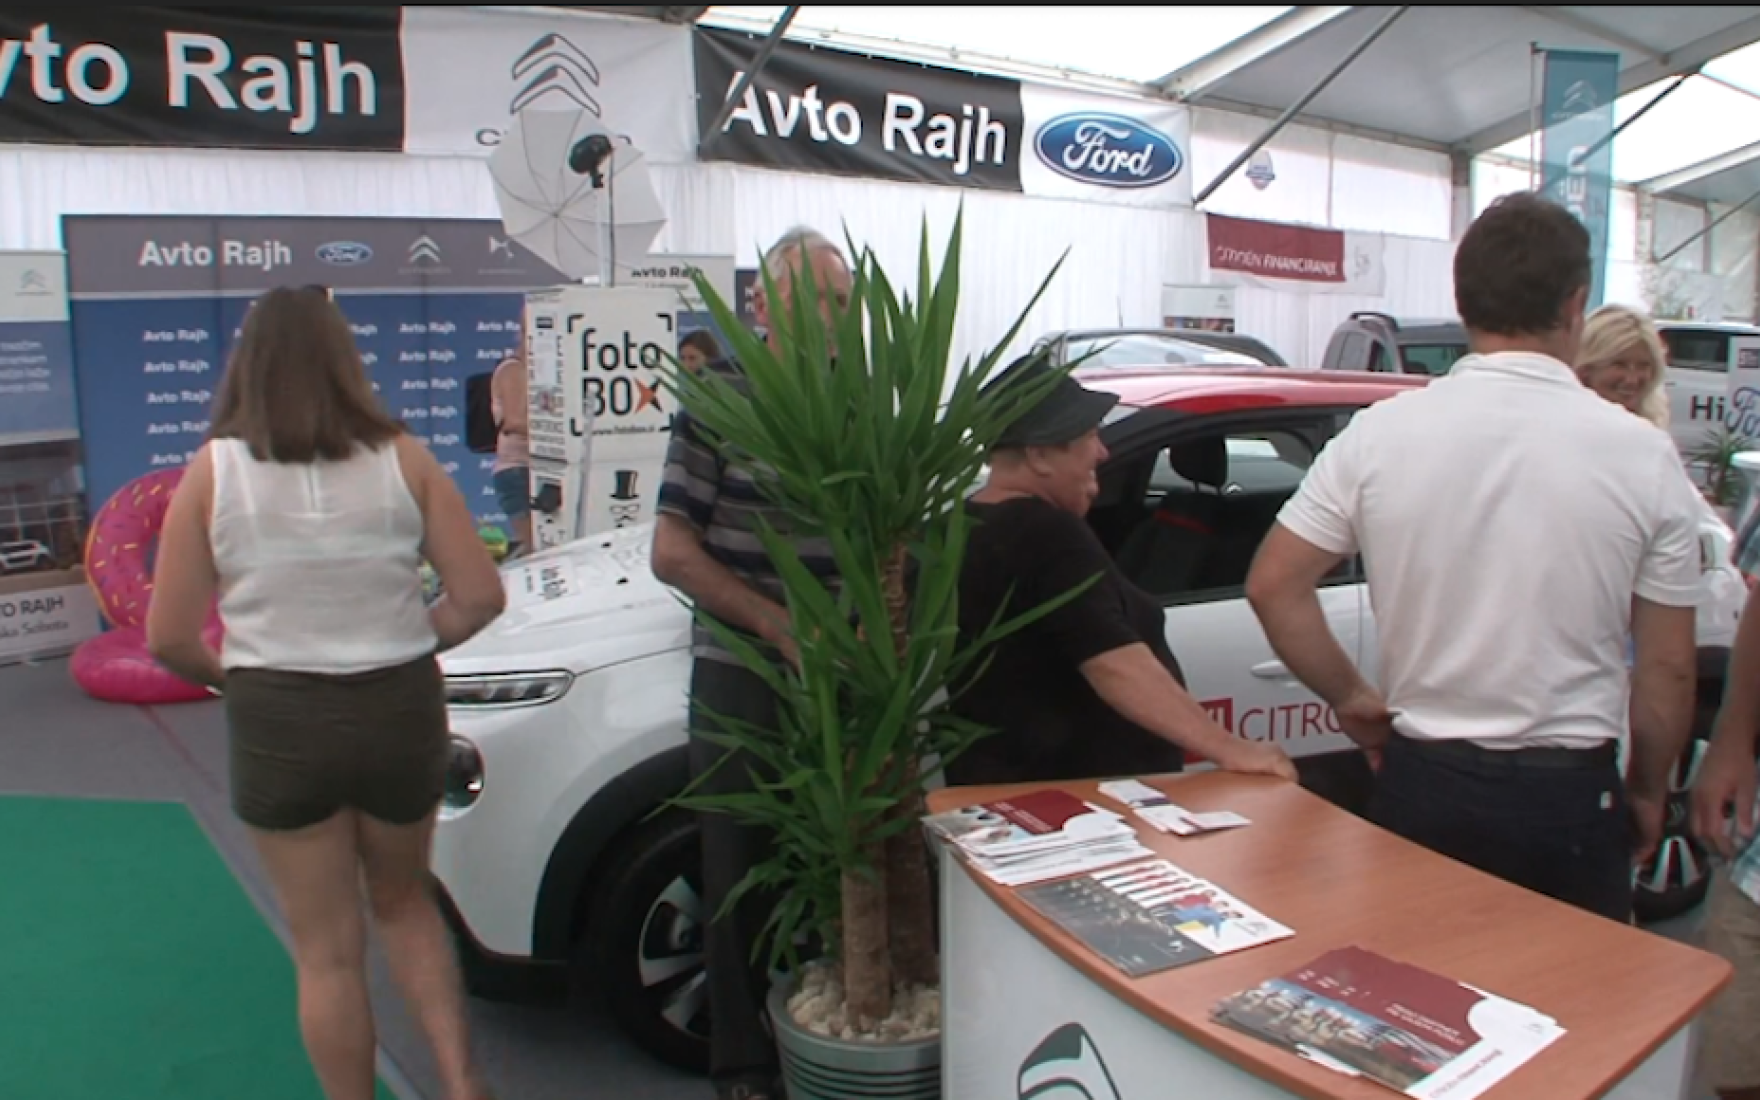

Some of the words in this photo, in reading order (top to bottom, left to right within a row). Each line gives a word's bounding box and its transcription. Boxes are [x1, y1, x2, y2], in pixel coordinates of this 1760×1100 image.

[165, 30, 376, 134] Rajh
[722, 71, 863, 145] Avto
[882, 92, 1005, 176] Rajh
[1063, 121, 1155, 177] Ford
[138, 239, 213, 266] Avto
[222, 240, 292, 272] Rajh
[400, 323, 427, 333] Avto
[428, 321, 456, 334] Rajh
[476, 321, 503, 332] Avto
[143, 331, 175, 341] Avto
[178, 329, 209, 343] Rajh
[400, 351, 427, 362] Avto
[428, 349, 456, 362] Rajh
[476, 348, 503, 359] Avto
[581, 327, 661, 371] foto
[143, 362, 176, 372] Avto
[178, 360, 210, 374] Rajh
[401, 379, 428, 390] Avto
[430, 378, 458, 391] Rajh
[146, 392, 179, 403] Avto
[582, 376, 663, 416] BOX
[402, 407, 428, 418] Avto
[430, 405, 457, 418] Rajh
[147, 423, 179, 433] Avto
[20, 595, 65, 615] RAJH
